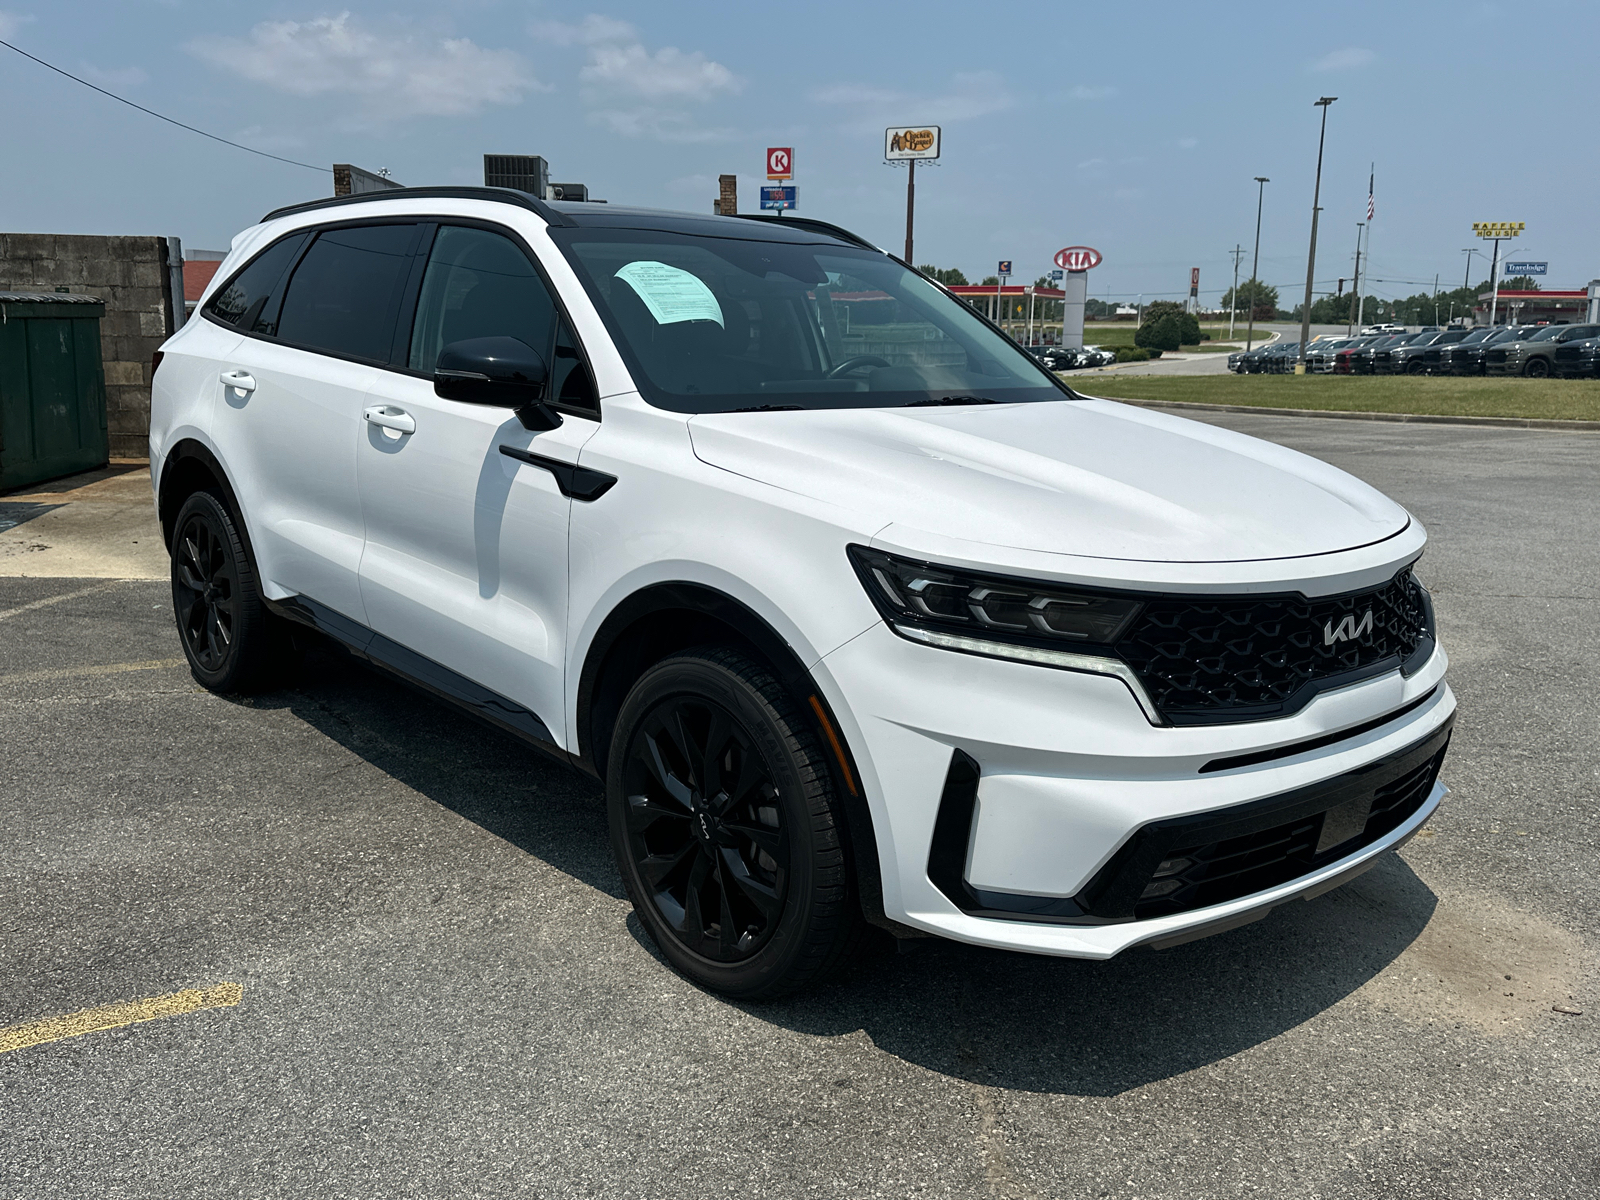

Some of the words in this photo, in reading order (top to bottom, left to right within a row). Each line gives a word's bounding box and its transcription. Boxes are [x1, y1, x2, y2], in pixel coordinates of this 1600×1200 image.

[775, 154, 786, 170] K
[1062, 252, 1092, 266] KIA
[1508, 263, 1545, 272] Travelodge
[1324, 610, 1374, 646] KIA
[755, 720, 794, 787] MAVIS
